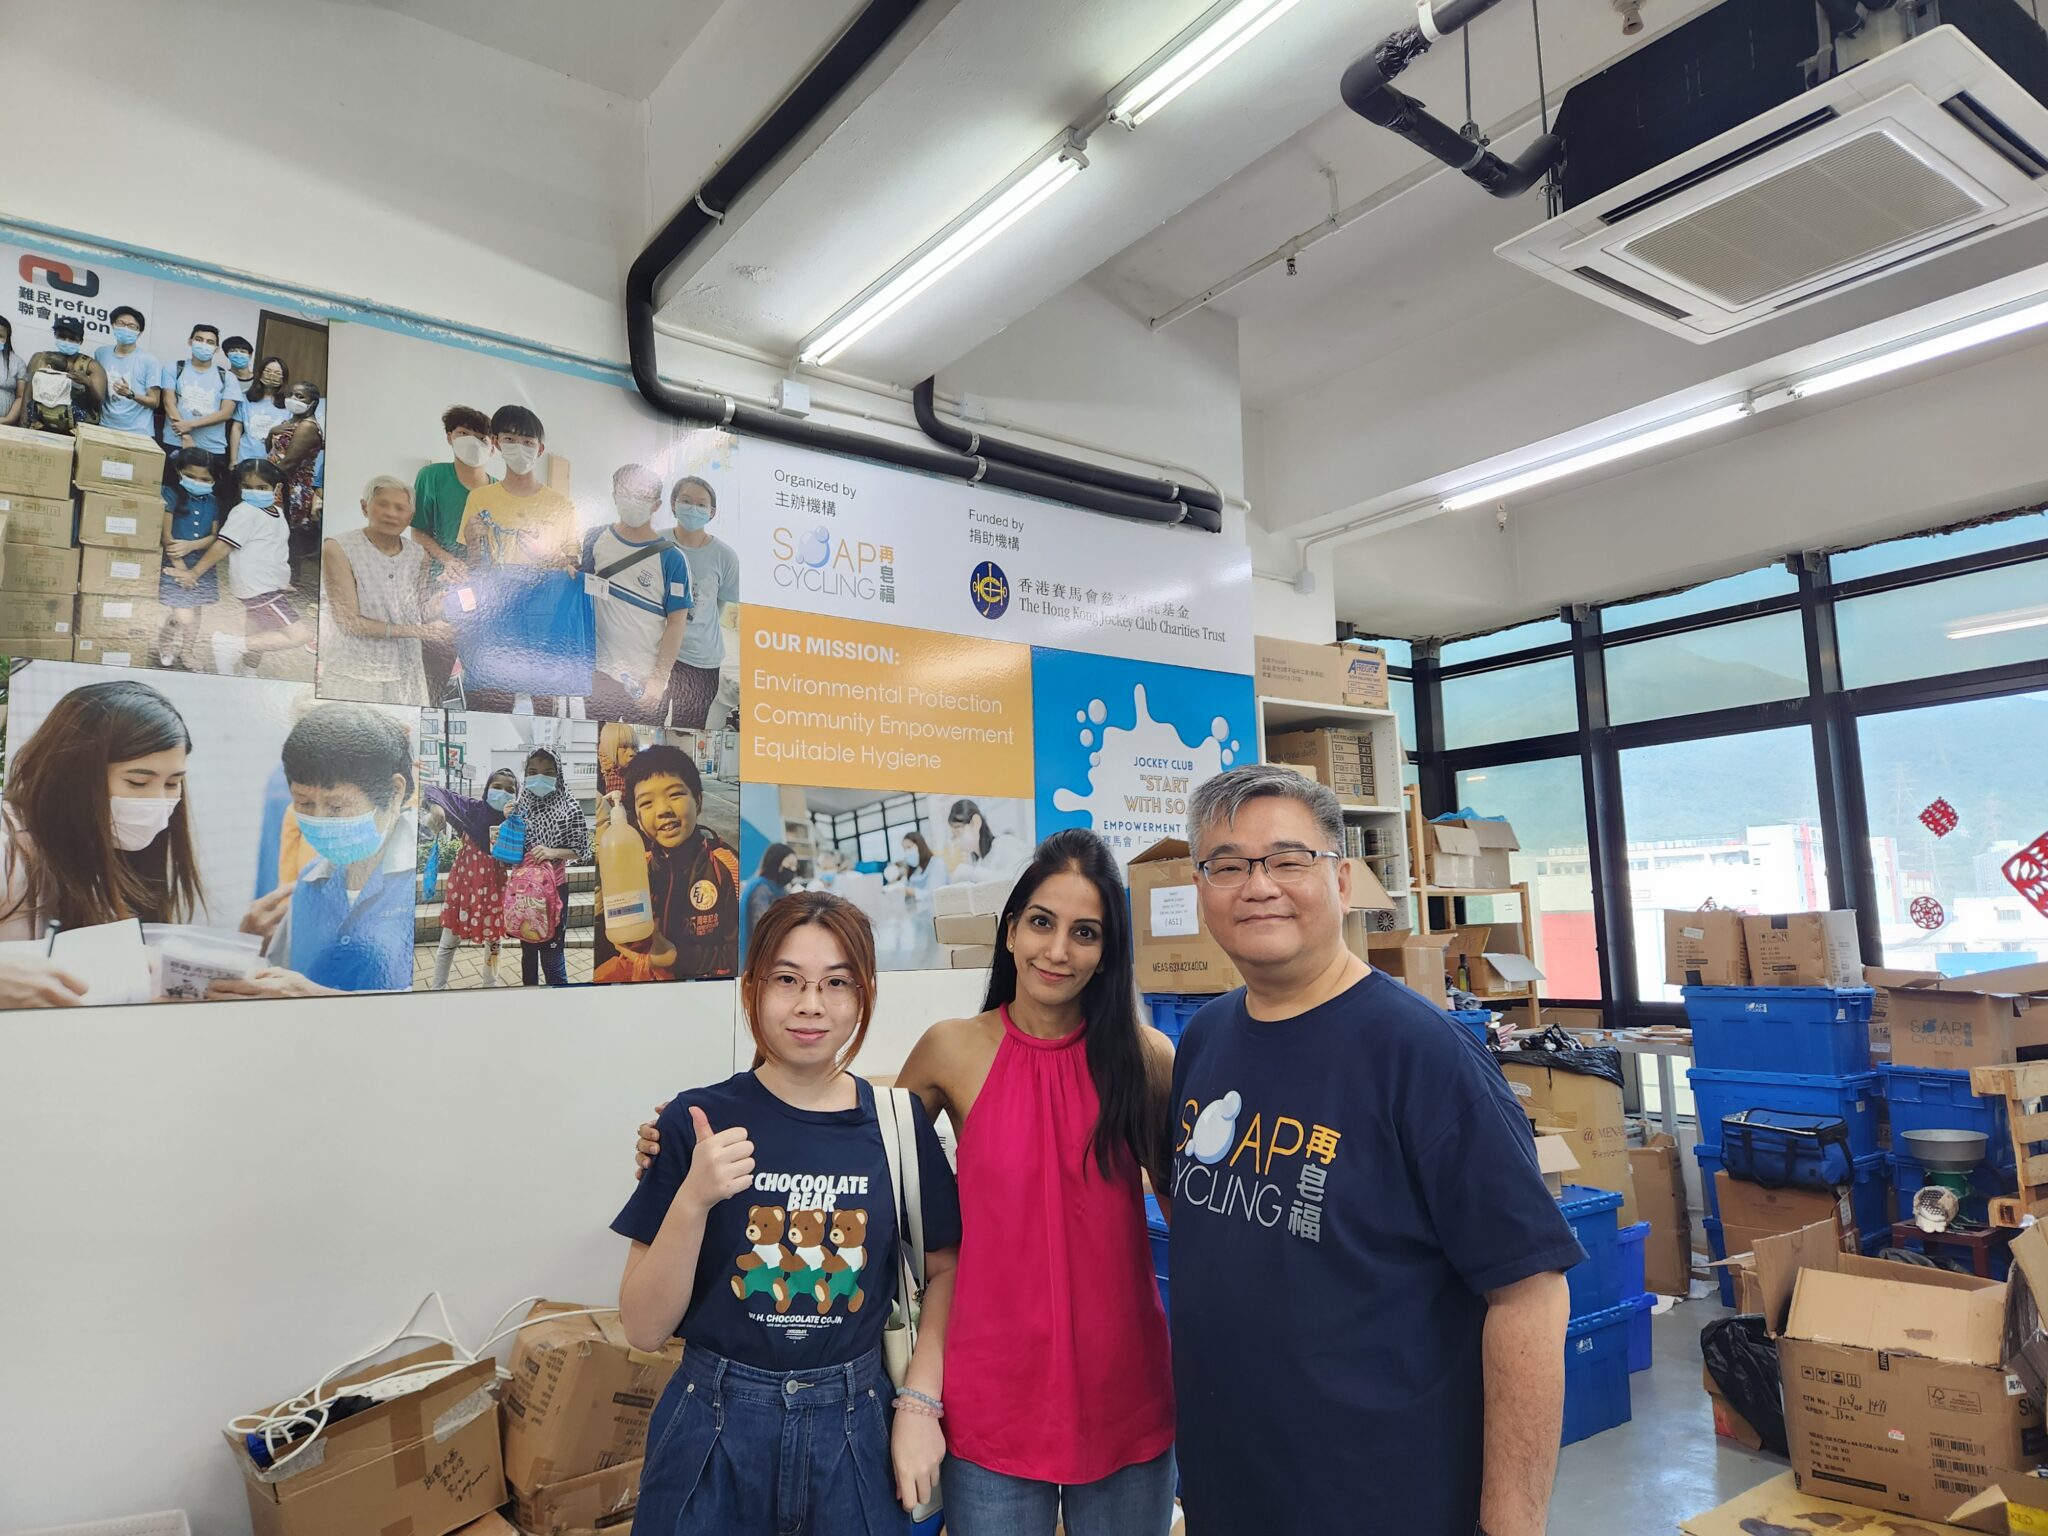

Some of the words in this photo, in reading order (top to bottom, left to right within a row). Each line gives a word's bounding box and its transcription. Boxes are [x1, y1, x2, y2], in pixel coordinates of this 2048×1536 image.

[18, 286, 52, 306] 難民
[55, 298, 109, 321] refug
[18, 301, 52, 320] 聯會
[774, 469, 839, 493] Organized
[842, 483, 857, 500] by
[775, 490, 837, 517] 主辦機構
[968, 508, 1009, 528] Funded
[1011, 519, 1025, 533] by
[968, 528, 1021, 551] 捐助機構
[773, 563, 877, 601] CYCLING
[1018, 597, 1040, 614] The
[1042, 601, 1071, 622] Hong
[1073, 606, 1098, 627] Kong
[1099, 611, 1134, 631] Jockey
[1135, 616, 1157, 632] Club
[1159, 620, 1201, 639] Charities
[1202, 627, 1226, 642] Trust
[754, 629, 801, 653] OUR
[806, 636, 900, 665] MISSION:
[754, 669, 902, 704] Environmental
[908, 687, 1003, 714] Protection
[753, 702, 876, 736] Community
[880, 714, 1014, 746] Empowerment
[754, 736, 856, 763] Equitable
[861, 744, 942, 770] Hygiene
[1133, 757, 1169, 770] JOCKEY
[1171, 760, 1194, 771] CLUB
[1124, 795, 1162, 814] WITH
[1165, 797, 1190, 815] SO
[1103, 820, 1181, 833] EMPOWERMENT
[754, 1172, 869, 1195] CHOCOOLATE
[1172, 1157, 1283, 1228] YCLING
[786, 1192, 837, 1213] BEAR
[766, 1314, 820, 1324] CHOCOOLATE
